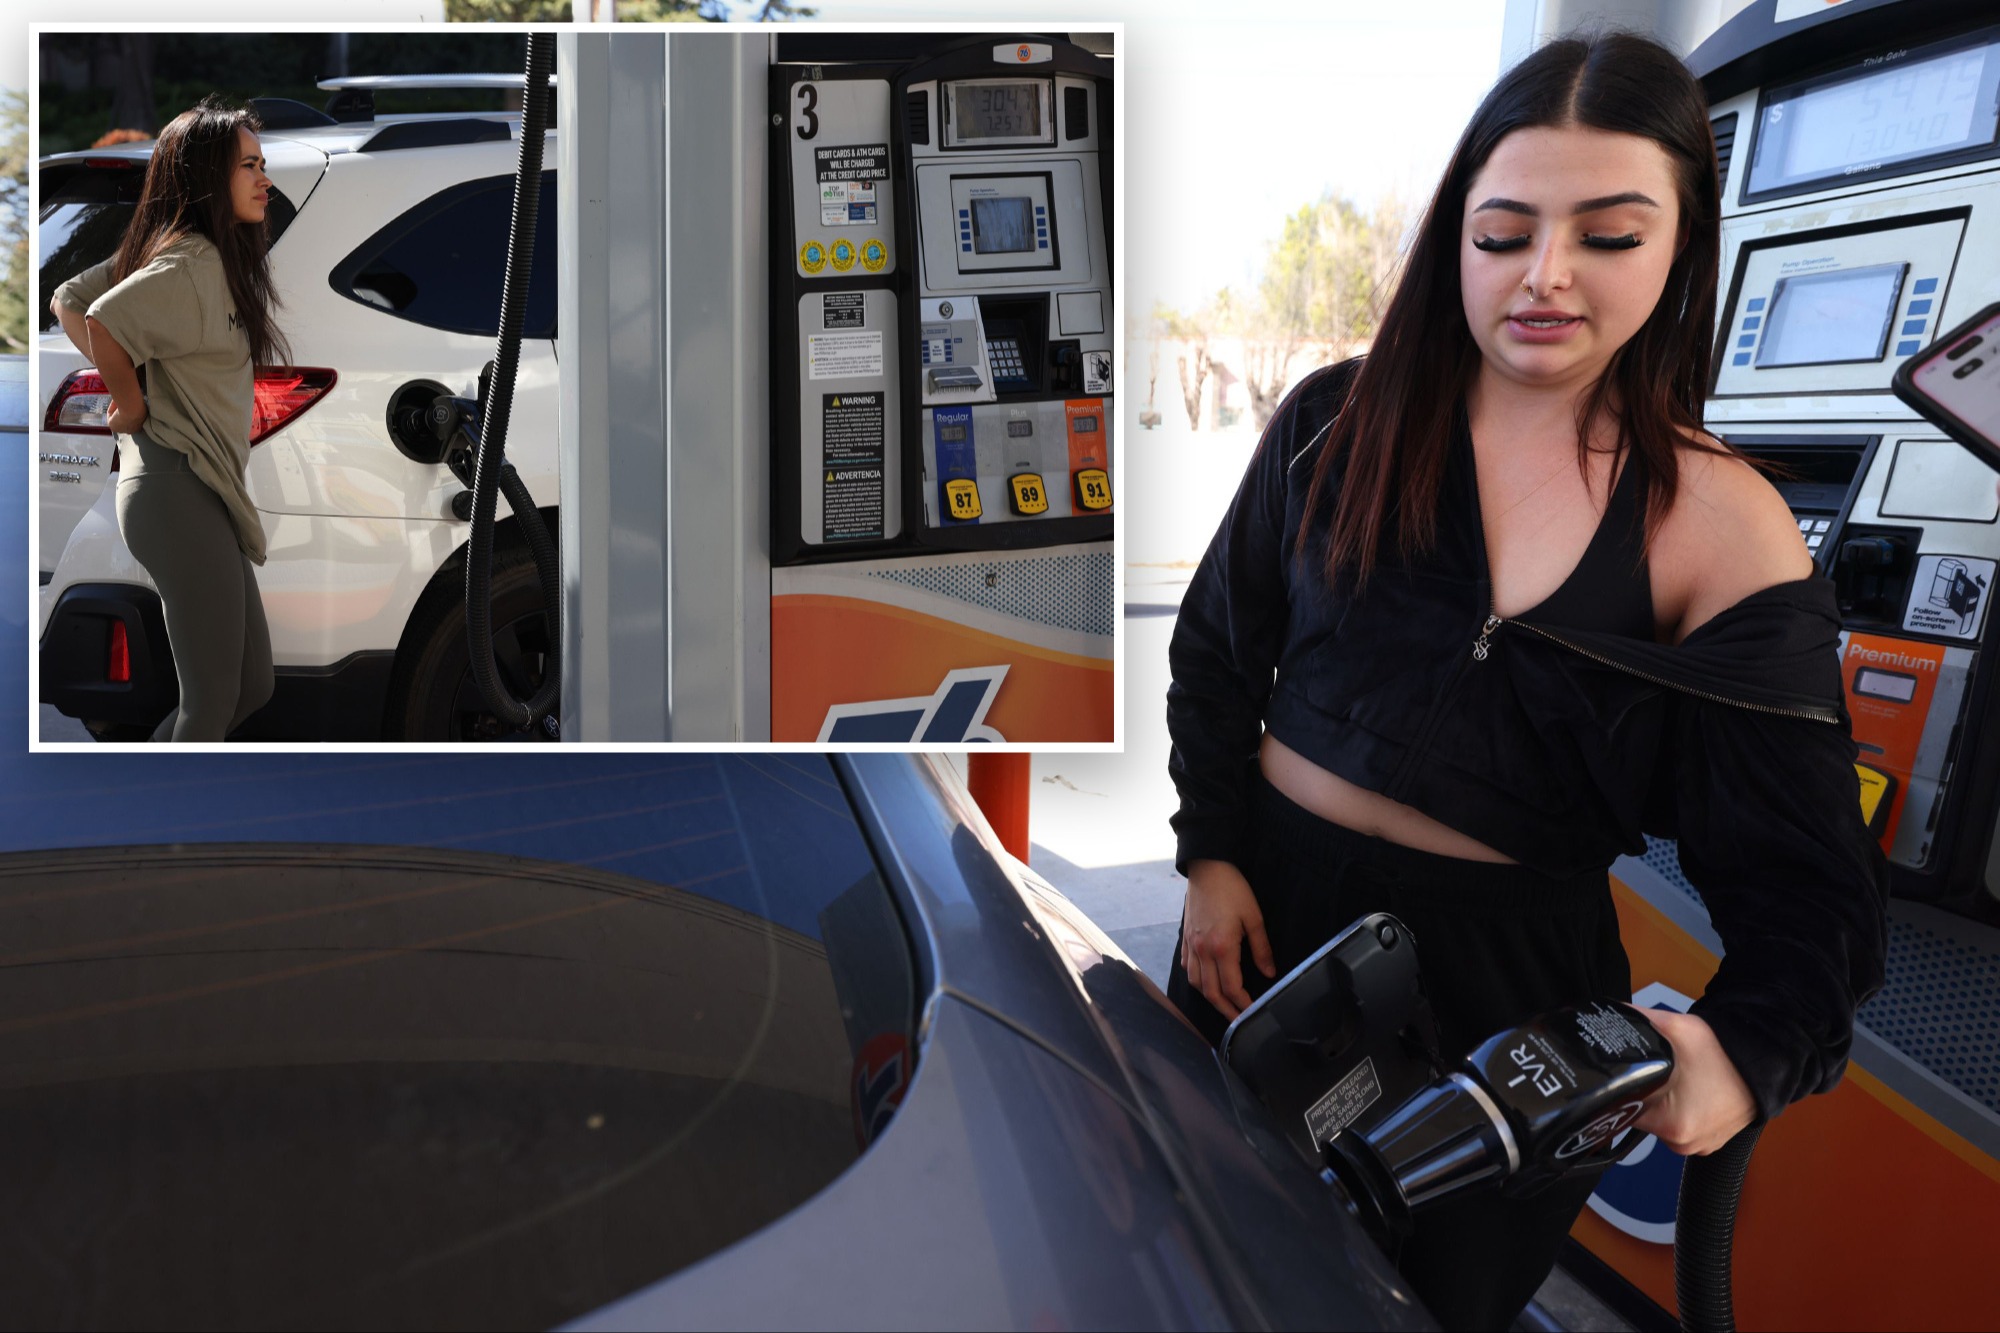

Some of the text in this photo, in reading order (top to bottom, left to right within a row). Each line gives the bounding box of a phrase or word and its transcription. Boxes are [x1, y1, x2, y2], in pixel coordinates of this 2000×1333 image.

[797, 84, 818, 140] 3
[1770, 103, 1783, 124] $
[818, 147, 885, 159] DEBIT CARDS & ATM CARDS
[830, 159, 874, 169] WILL BE CHARGED
[821, 168, 886, 180] AT THE CREDIT CARD PRICE
[842, 396, 875, 405] WARNING
[1010, 409, 1027, 417] Plus
[1066, 404, 1102, 415] Premium
[937, 413, 969, 424] Regular
[39, 453, 100, 467] UTBACK
[836, 470, 881, 480] ADVERTENCIA
[1021, 486, 1039, 502] 89
[1087, 482, 1105, 498] 91
[955, 493, 972, 508] 87
[1913, 607, 1941, 616] Follow
[1910, 621, 1946, 630] prompts
[1912, 614, 1955, 624] on-screen
[1849, 644, 1936, 671] Premium
[1576, 1018, 1613, 1055] WARNING
[1510, 1043, 1563, 1097] EVR
[1311, 1066, 1369, 1121] PREMIUM UNLEADED
[1325, 1084, 1360, 1118] FUEL ONLY
[1315, 1081, 1375, 1137] SUPER SANS PLOMB
[1331, 1099, 1364, 1133] SEULEMENT
